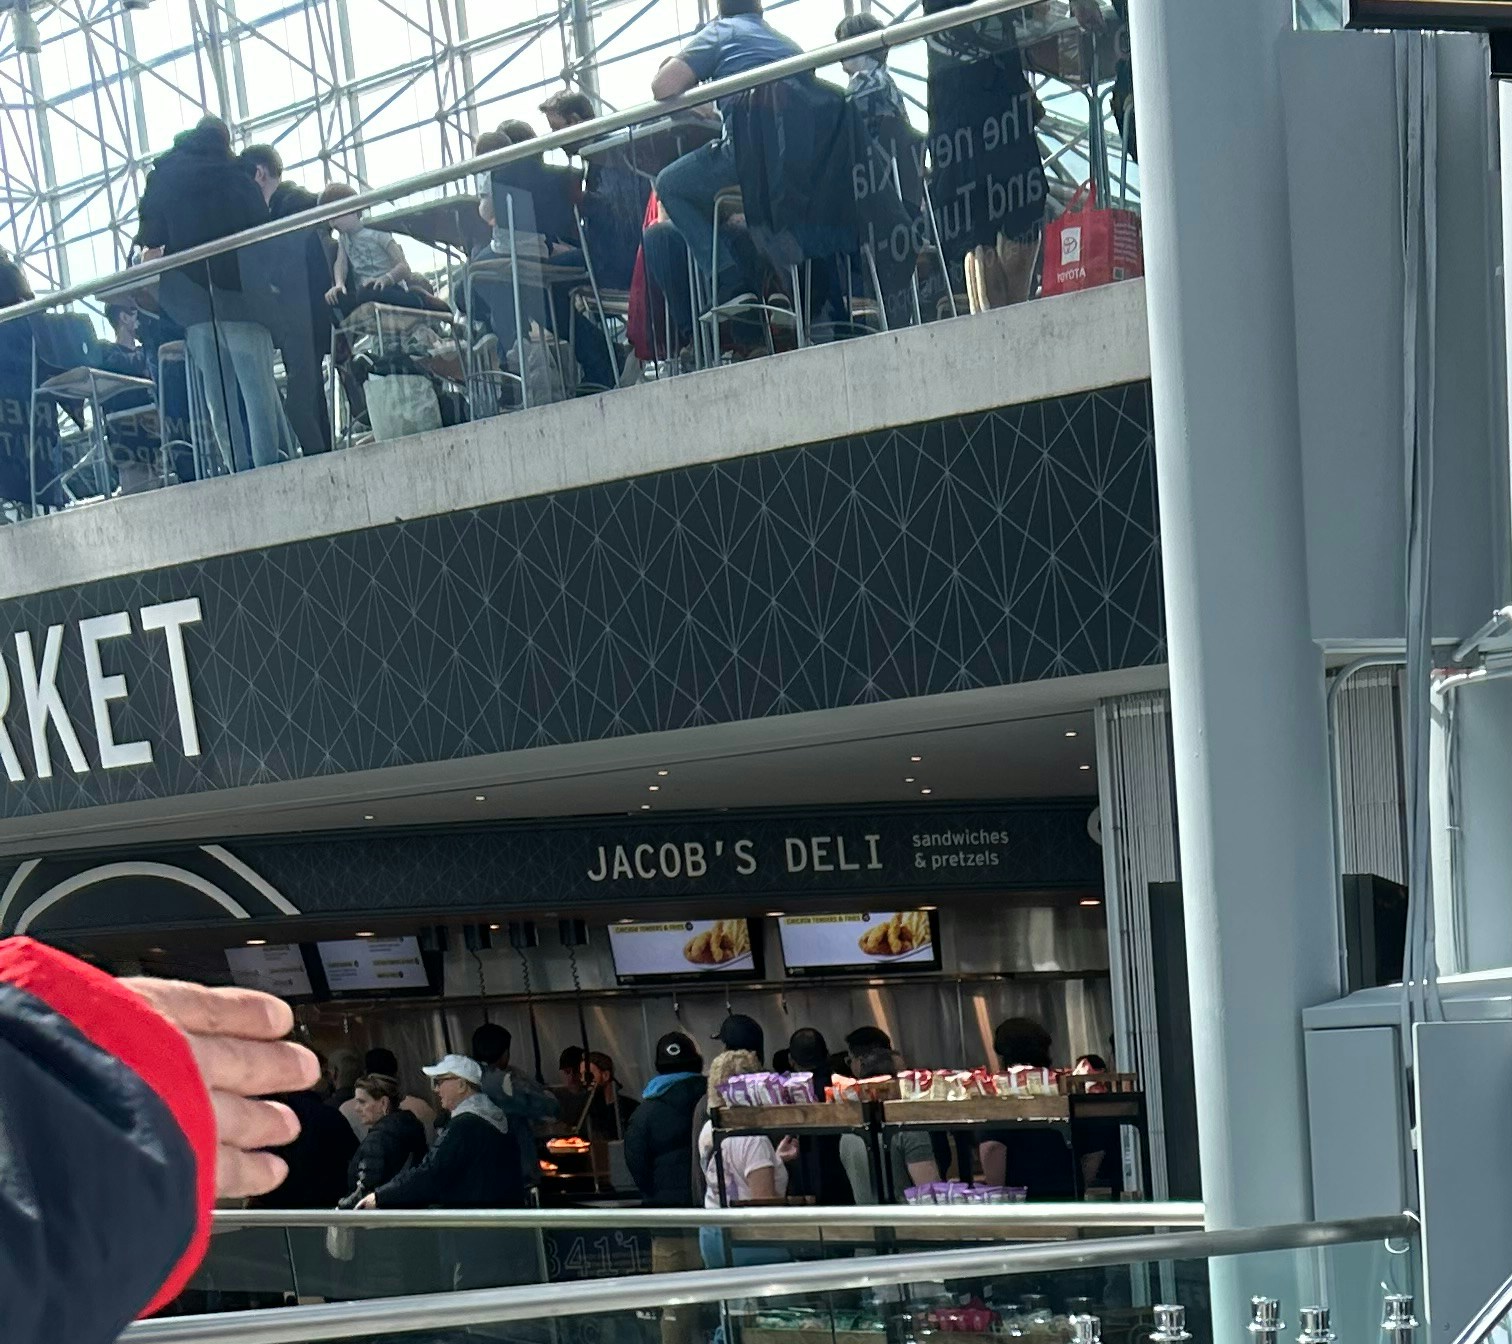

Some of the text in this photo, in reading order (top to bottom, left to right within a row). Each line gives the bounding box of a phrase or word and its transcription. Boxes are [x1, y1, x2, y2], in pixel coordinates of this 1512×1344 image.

[912, 828, 1009, 849] sandwiches
[587, 834, 883, 883] JACOB'S DELI
[914, 851, 1000, 871] & pretzels
